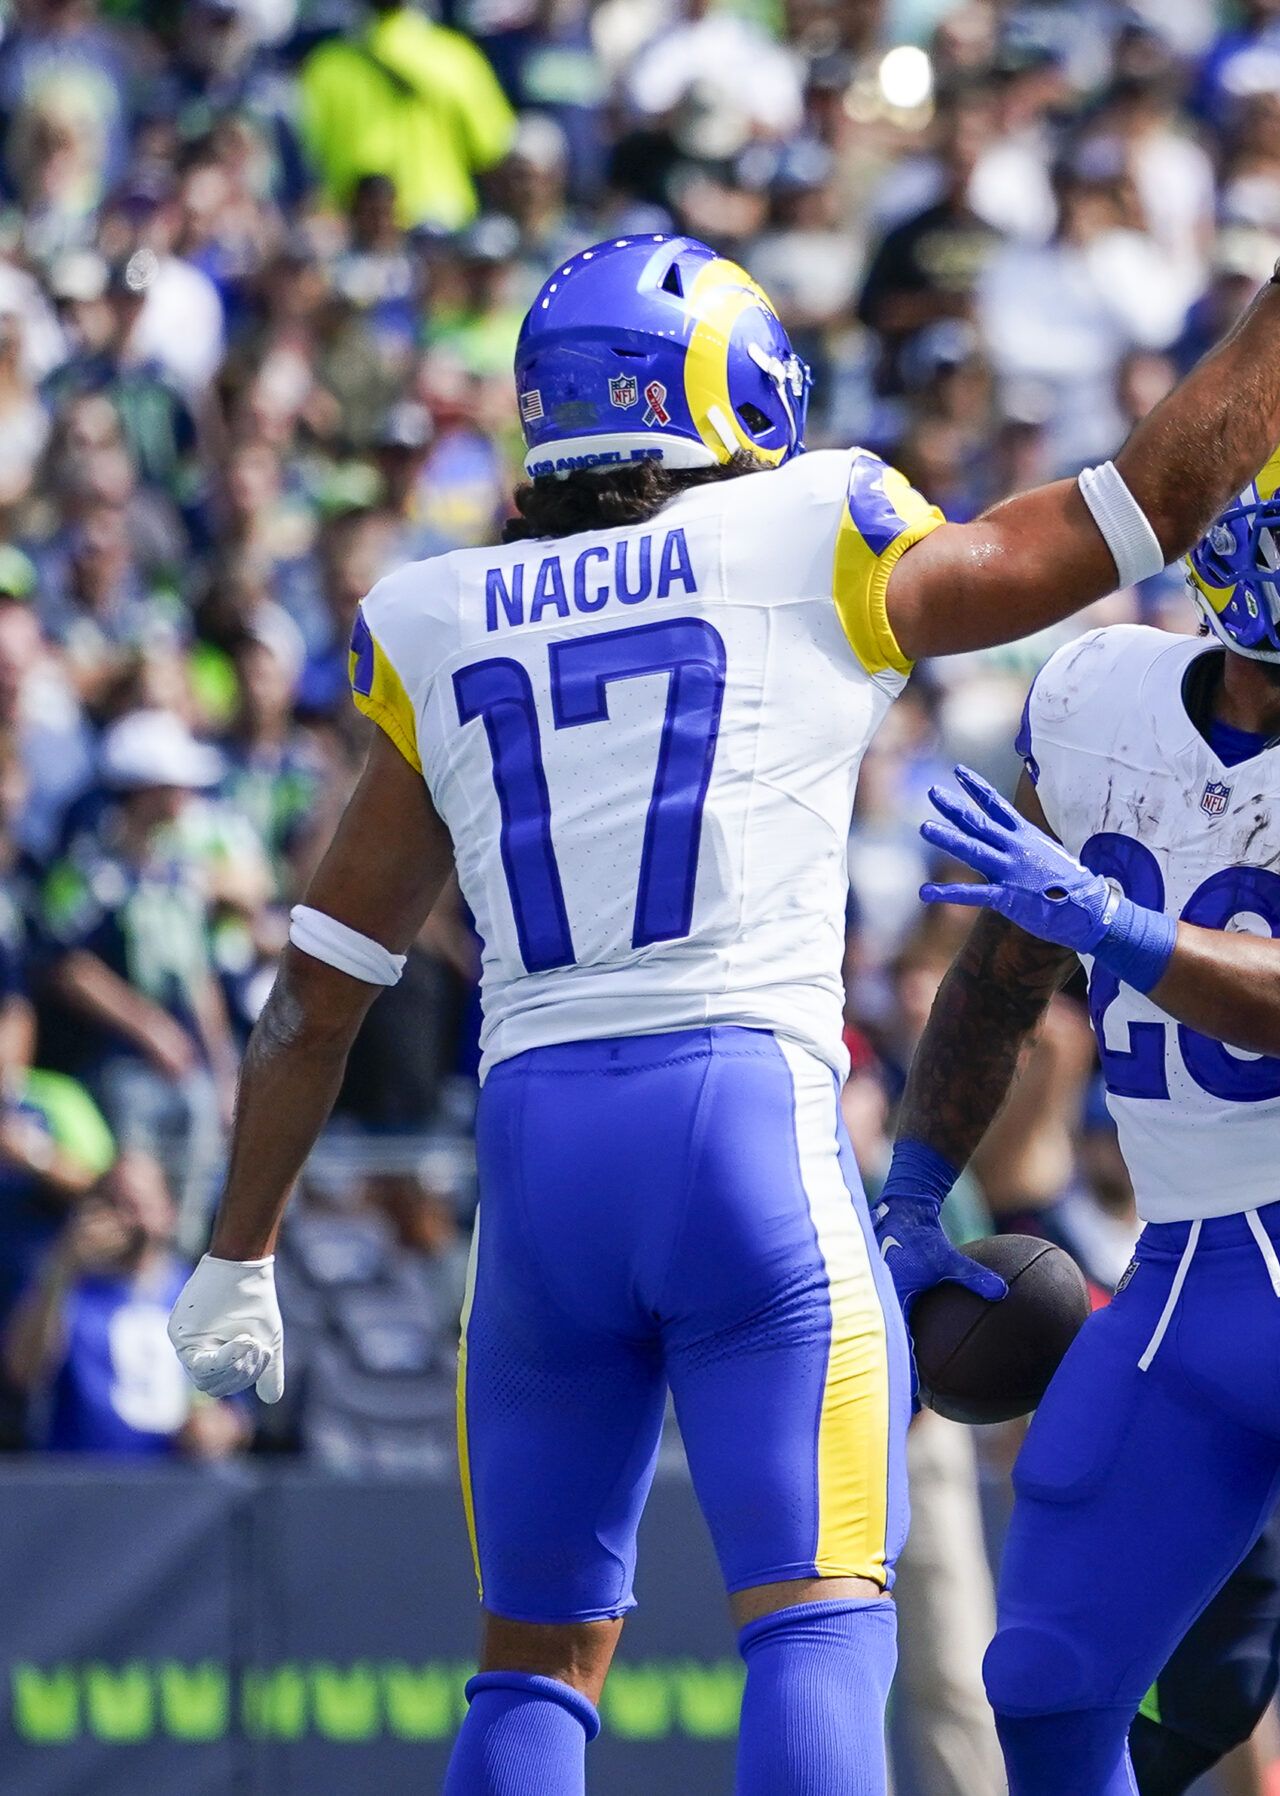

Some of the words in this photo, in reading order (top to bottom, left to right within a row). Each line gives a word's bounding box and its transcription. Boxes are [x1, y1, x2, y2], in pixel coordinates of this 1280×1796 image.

[556, 447, 664, 472] ANGELES
[485, 527, 698, 633] NACUA
[451, 616, 727, 975] 17
